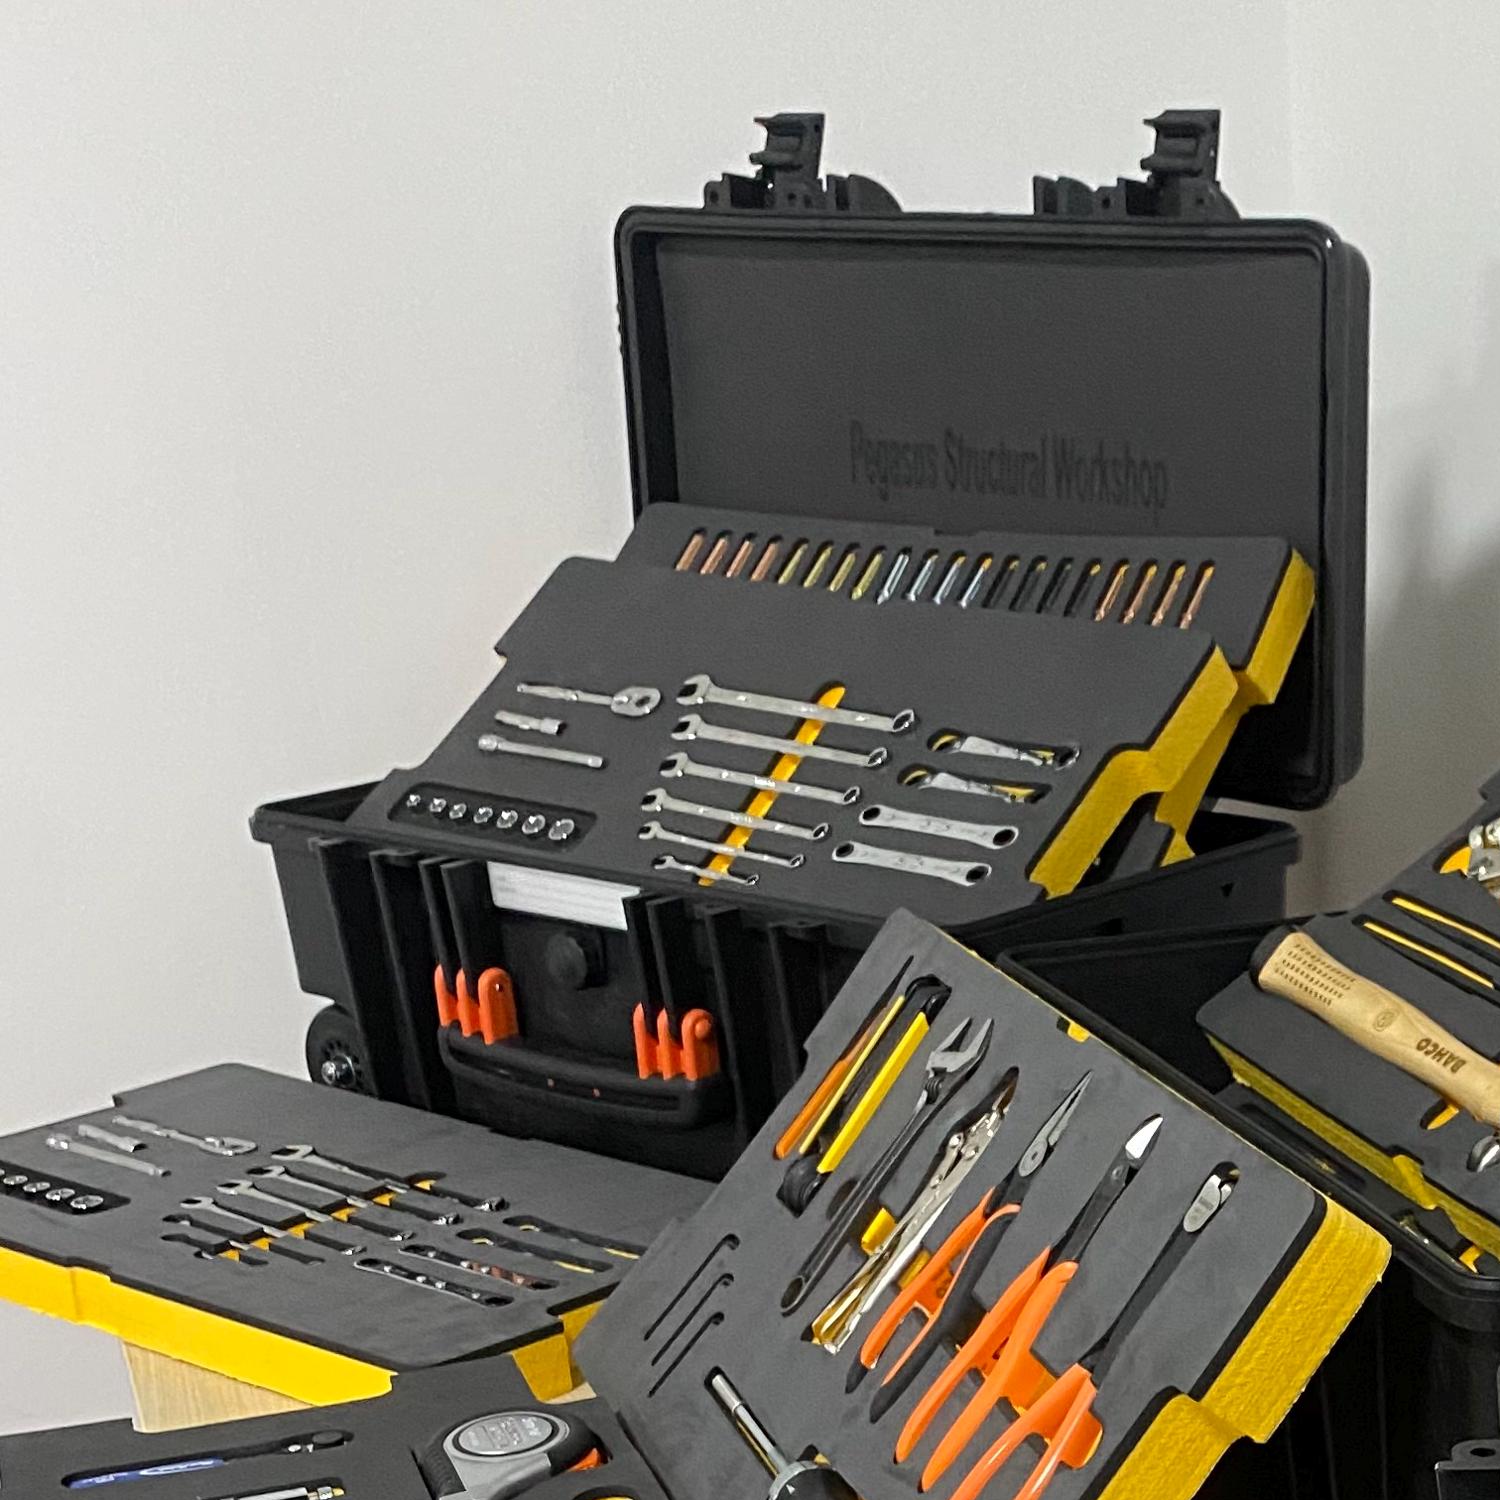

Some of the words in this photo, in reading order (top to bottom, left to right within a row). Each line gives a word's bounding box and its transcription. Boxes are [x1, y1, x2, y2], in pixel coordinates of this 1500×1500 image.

[850, 419, 939, 502] Pegasus
[943, 427, 1048, 500] Structural
[1050, 433, 1168, 528] Workshop
[1415, 1036, 1468, 1075] BAHCO
